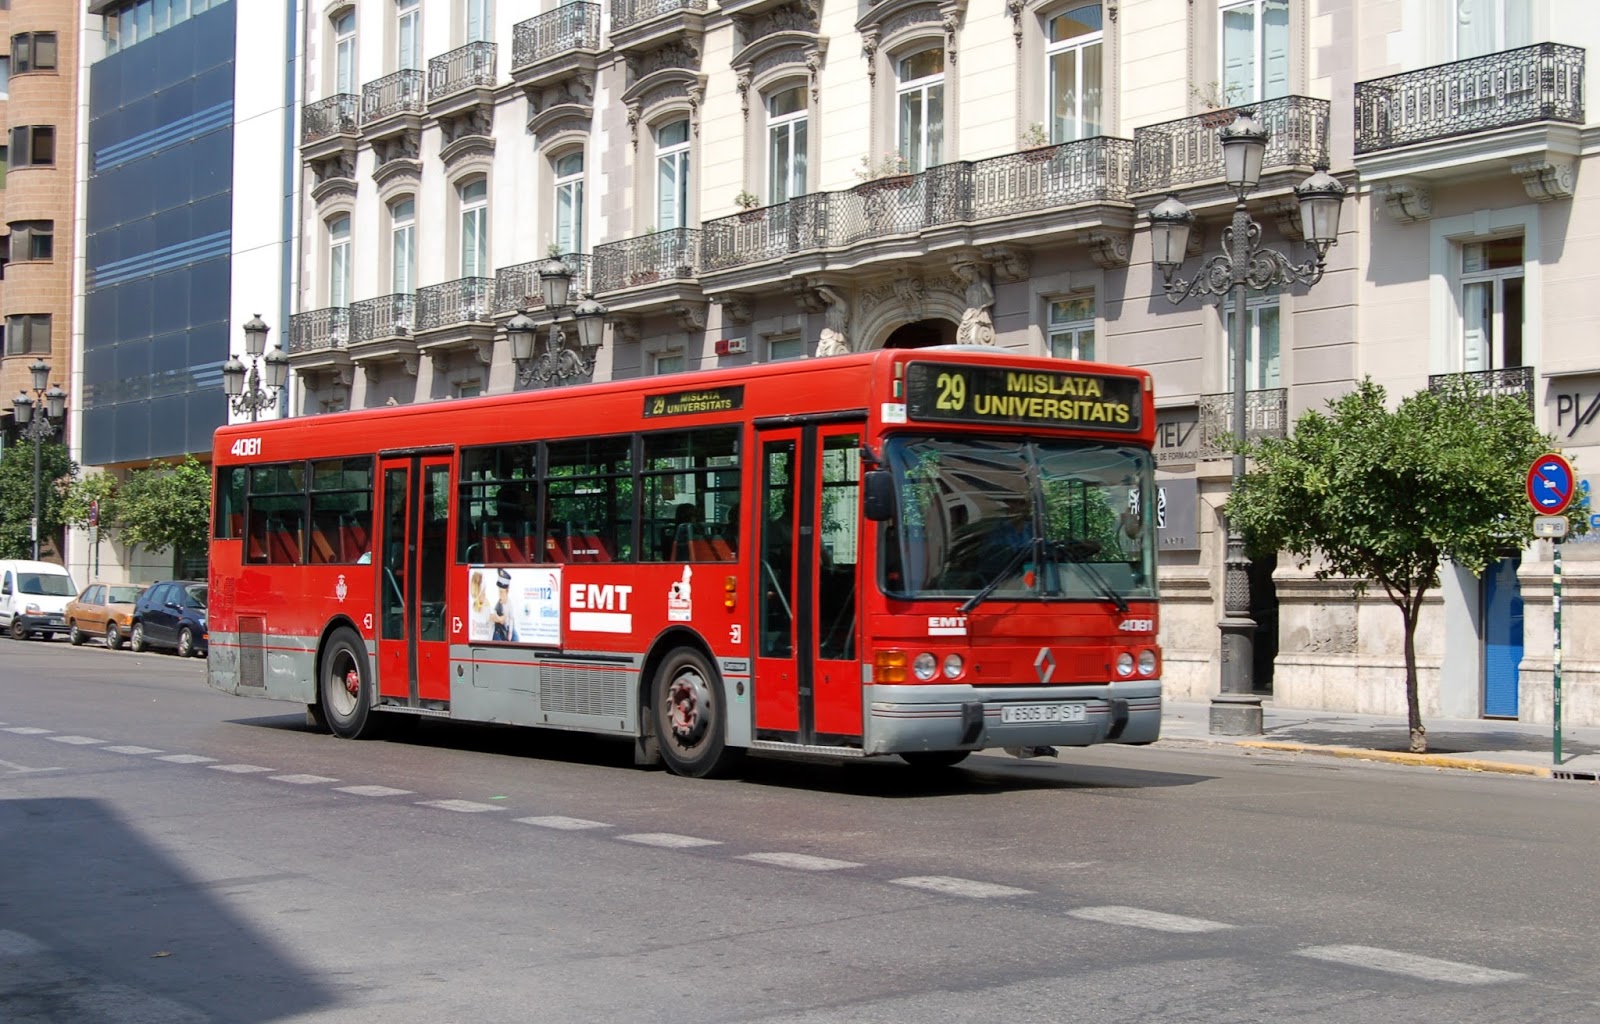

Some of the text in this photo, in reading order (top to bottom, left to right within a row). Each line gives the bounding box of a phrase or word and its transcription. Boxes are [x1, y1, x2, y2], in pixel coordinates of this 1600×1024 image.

[936, 373, 965, 411] 29
[1007, 373, 1101, 398] MISLATA
[653, 396, 665, 415] 29
[667, 399, 732, 414] UNIVERSITATS
[680, 391, 720, 403] MISLATA
[973, 394, 1130, 423] UNIVERSITATS
[231, 437, 262, 456] 4081
[540, 587, 552, 600] 112
[569, 583, 633, 611] EMT
[928, 616, 967, 629] EMT
[1118, 619, 1153, 632] 4081
